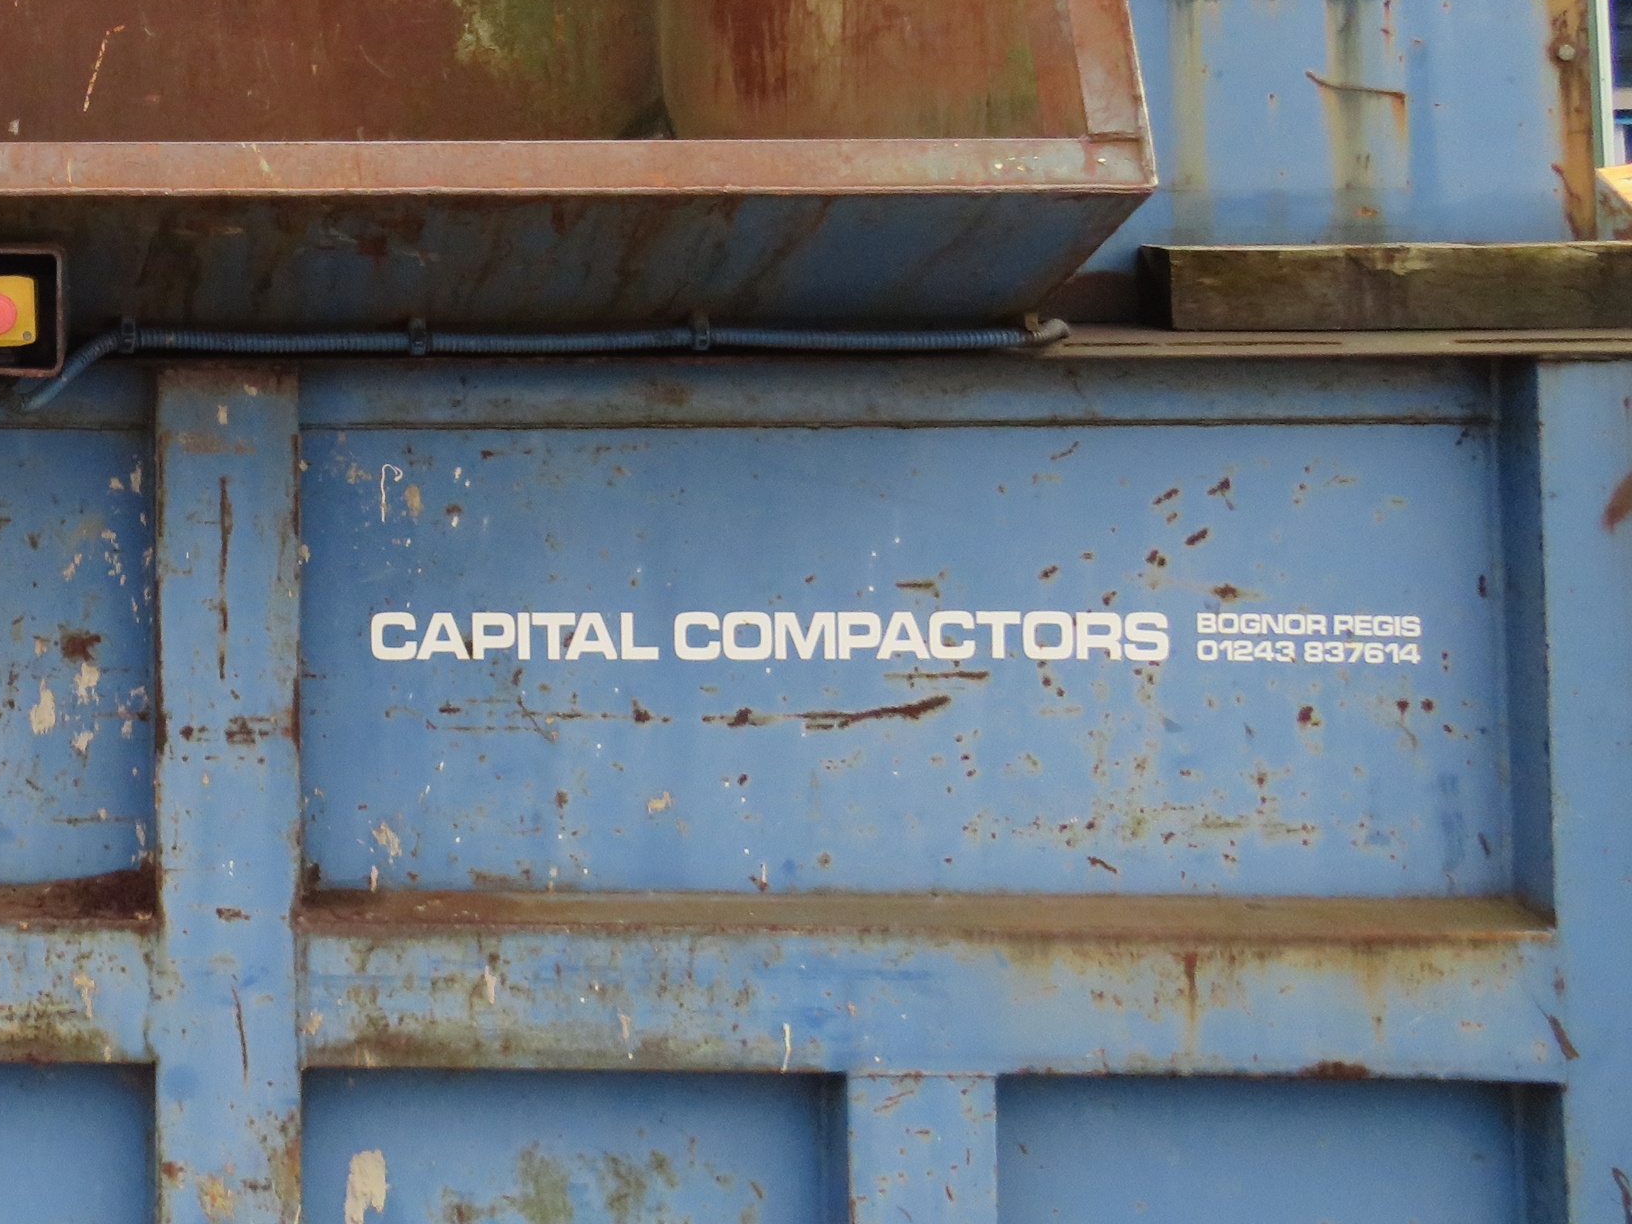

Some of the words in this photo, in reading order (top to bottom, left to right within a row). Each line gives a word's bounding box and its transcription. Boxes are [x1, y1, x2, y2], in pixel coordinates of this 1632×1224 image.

[1196, 612, 1327, 635] BOGNOR
[1333, 614, 1422, 637] REGIS
[370, 611, 658, 662] CAPITAL
[673, 611, 1170, 664] COMPACTORS
[1196, 639, 1296, 662] 01243
[1303, 640, 1421, 664] 837614
